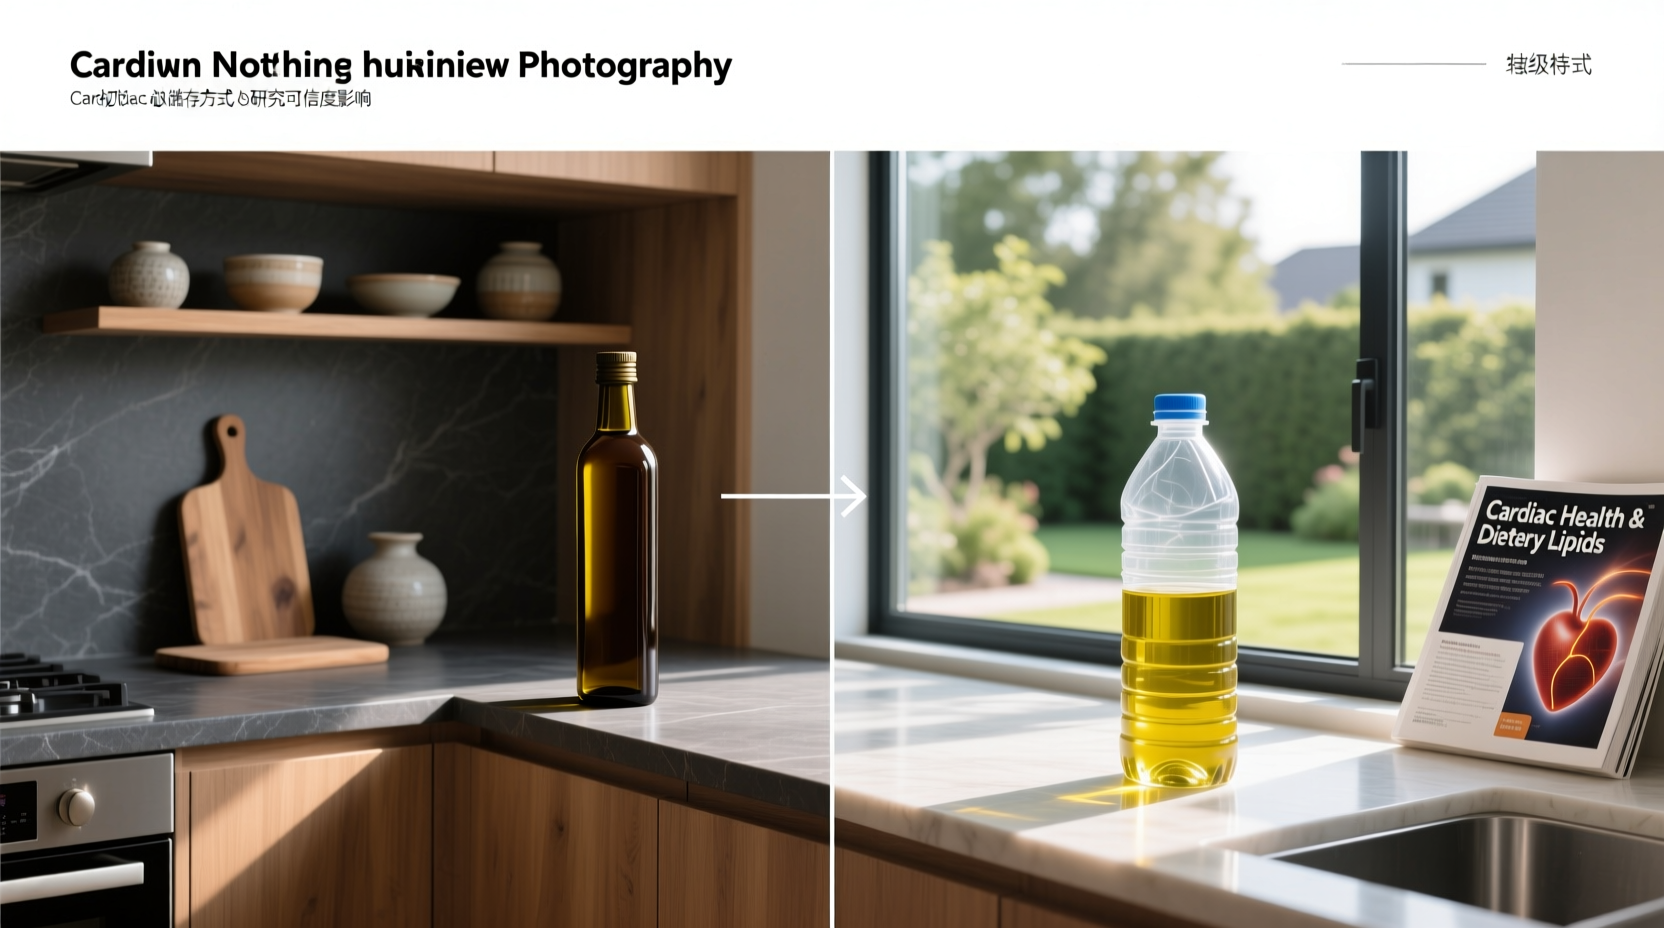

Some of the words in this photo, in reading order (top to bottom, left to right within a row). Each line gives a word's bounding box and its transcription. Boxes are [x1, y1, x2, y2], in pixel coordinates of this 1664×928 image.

[1486, 499, 1557, 525] Cardiac
[1560, 504, 1625, 529] Health
[1628, 507, 1645, 529] &
[1547, 529, 1606, 557] Lipids
